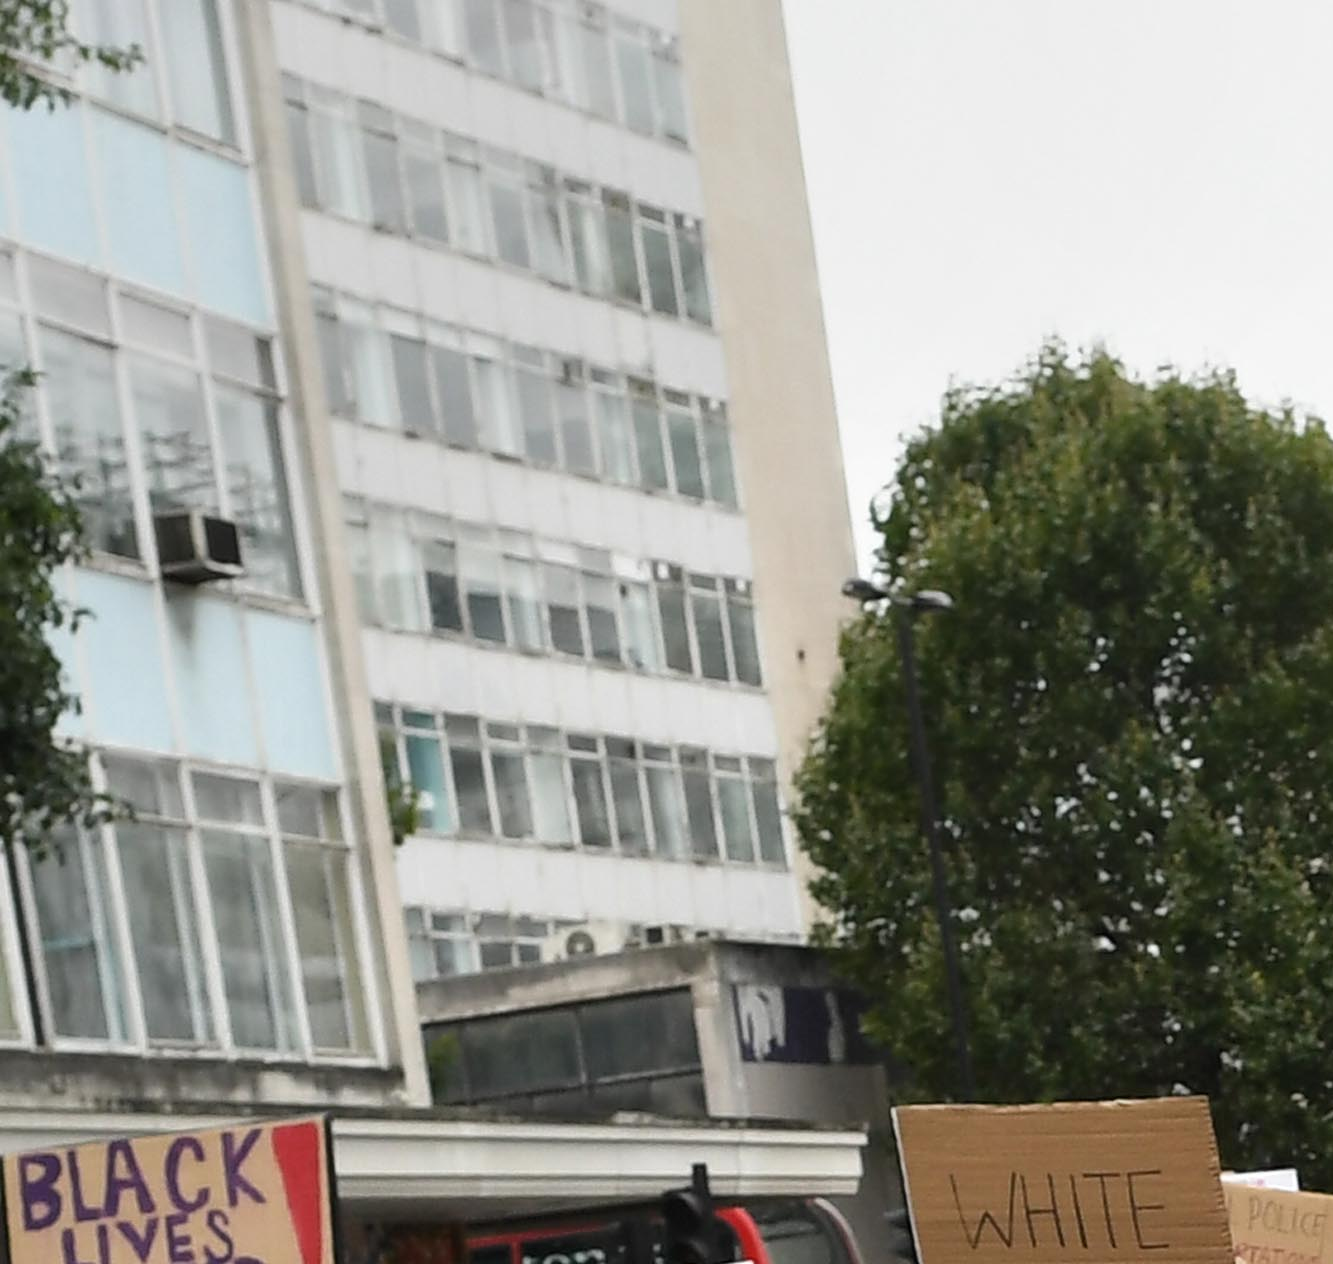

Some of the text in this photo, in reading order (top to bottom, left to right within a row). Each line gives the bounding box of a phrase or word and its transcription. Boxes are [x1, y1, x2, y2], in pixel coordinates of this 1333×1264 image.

[18, 1128, 267, 1231] BLACK
[948, 1168, 1172, 1250] WHITE
[1248, 1196, 1329, 1236] POLICE
